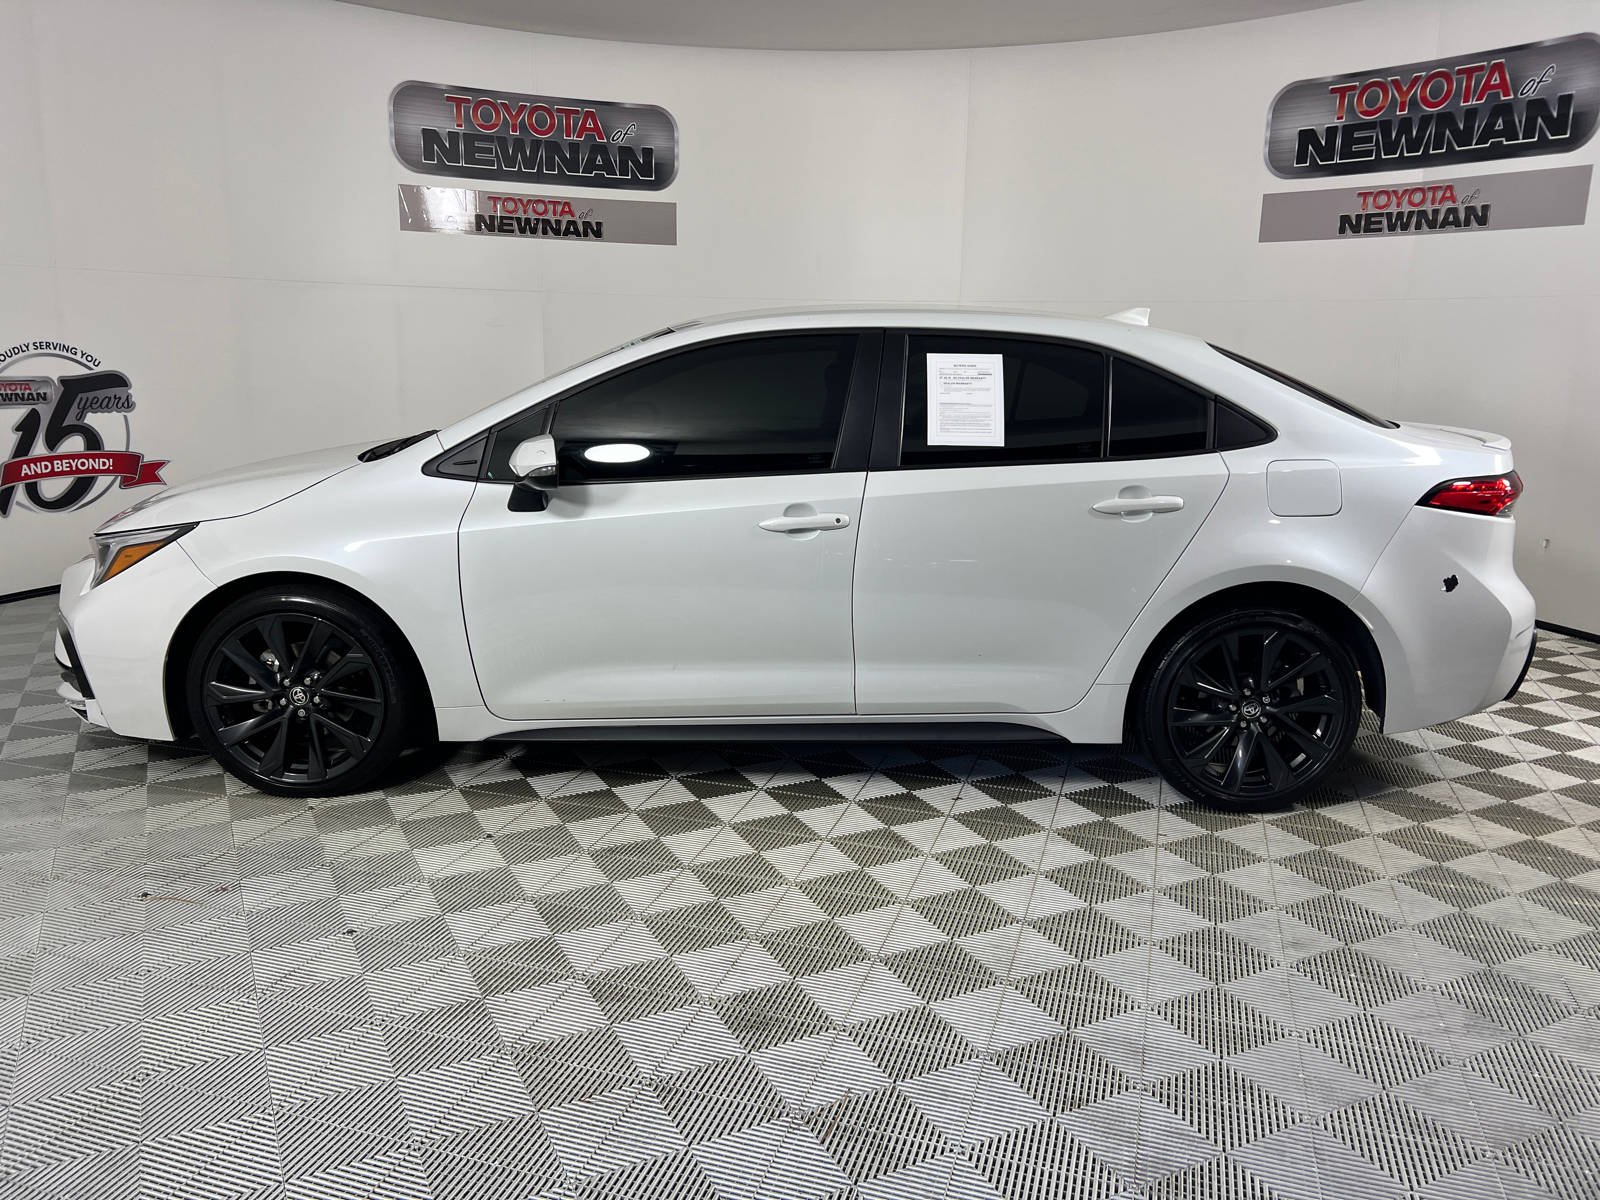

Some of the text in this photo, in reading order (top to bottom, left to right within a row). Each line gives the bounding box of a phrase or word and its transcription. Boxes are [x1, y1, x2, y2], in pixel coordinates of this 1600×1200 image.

[1329, 59, 1556, 122] TOYOTA of
[444, 94, 636, 143] TOYOTA of
[1294, 91, 1576, 167] NEWNAN
[421, 127, 655, 180] NEWNAN
[487, 196, 593, 219] TOYOTA of
[1356, 183, 1481, 212] TOYOTA of
[474, 214, 603, 240] NEWNAN
[1337, 203, 1491, 236] NEWNAN
[0, 341, 101, 368] OUDLY SERVING YOU
[0, 382, 32, 392] YOTA
[0, 392, 47, 402] WNAN
[75, 393, 134, 421] years
[21, 458, 114, 477] AND BEYOND!
